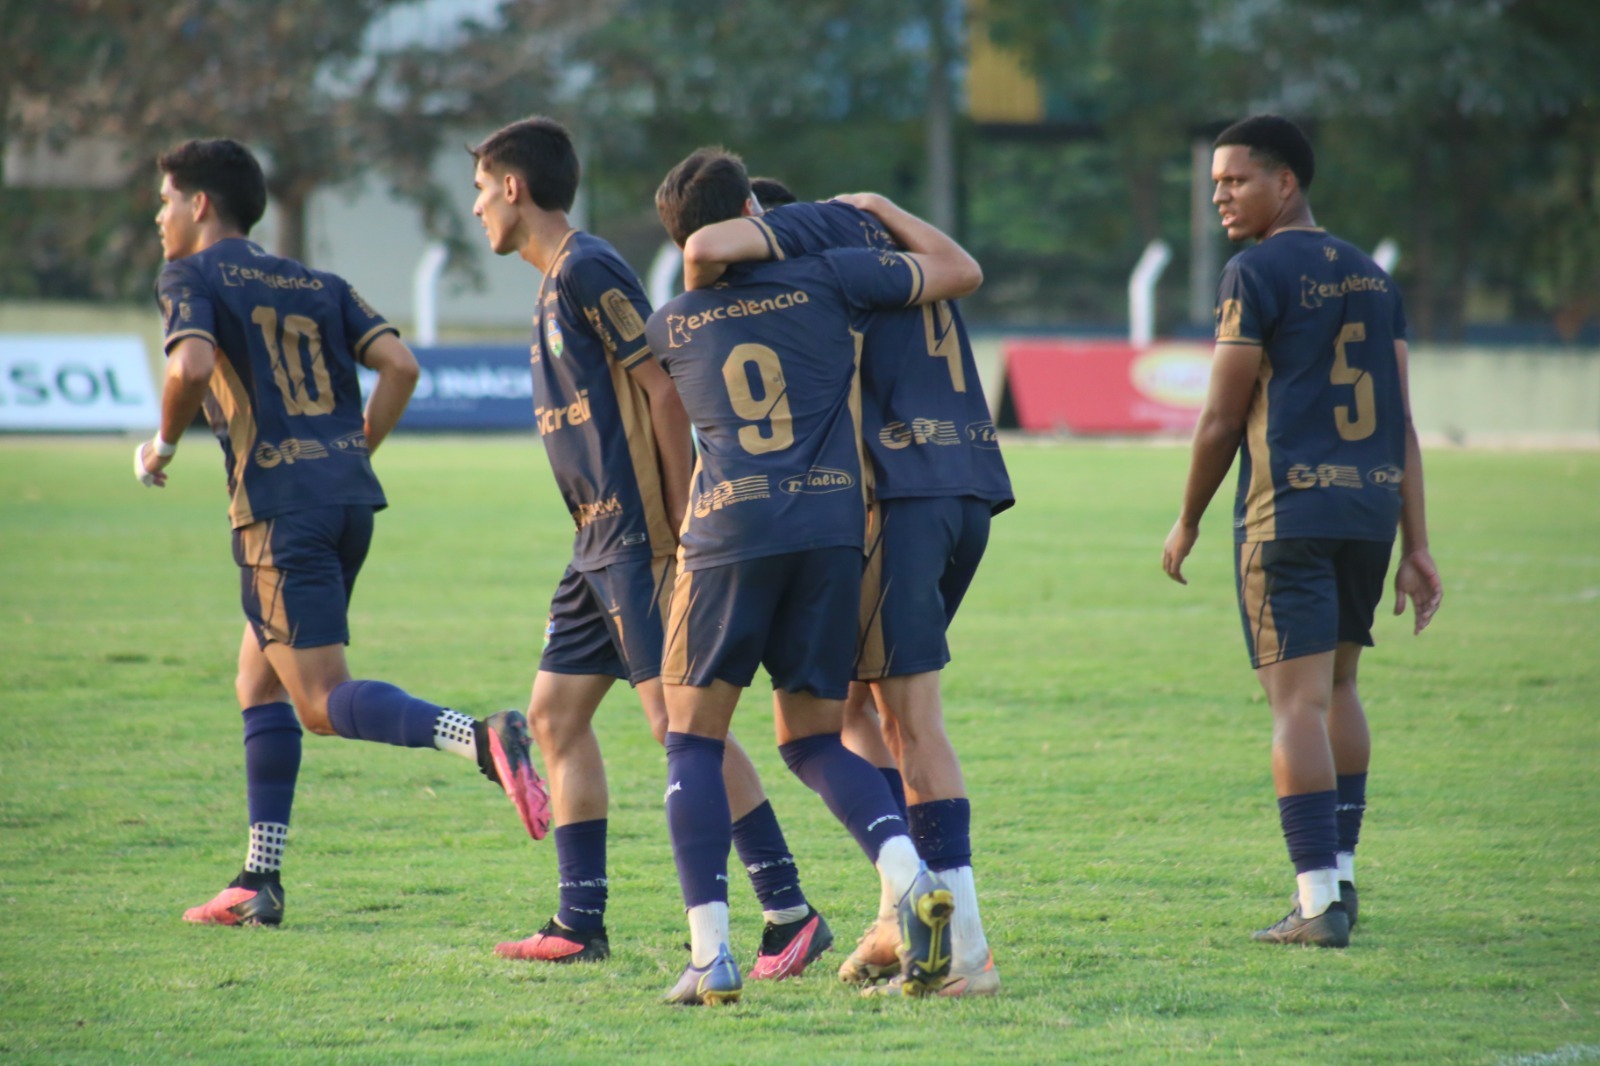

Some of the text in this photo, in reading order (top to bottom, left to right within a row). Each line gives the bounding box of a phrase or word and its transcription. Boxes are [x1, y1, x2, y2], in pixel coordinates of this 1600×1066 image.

[0, 361, 144, 406] SOL
[251, 305, 336, 416] 10
[722, 343, 794, 455] 9
[922, 300, 966, 393] 4
[1330, 321, 1376, 442] 5
